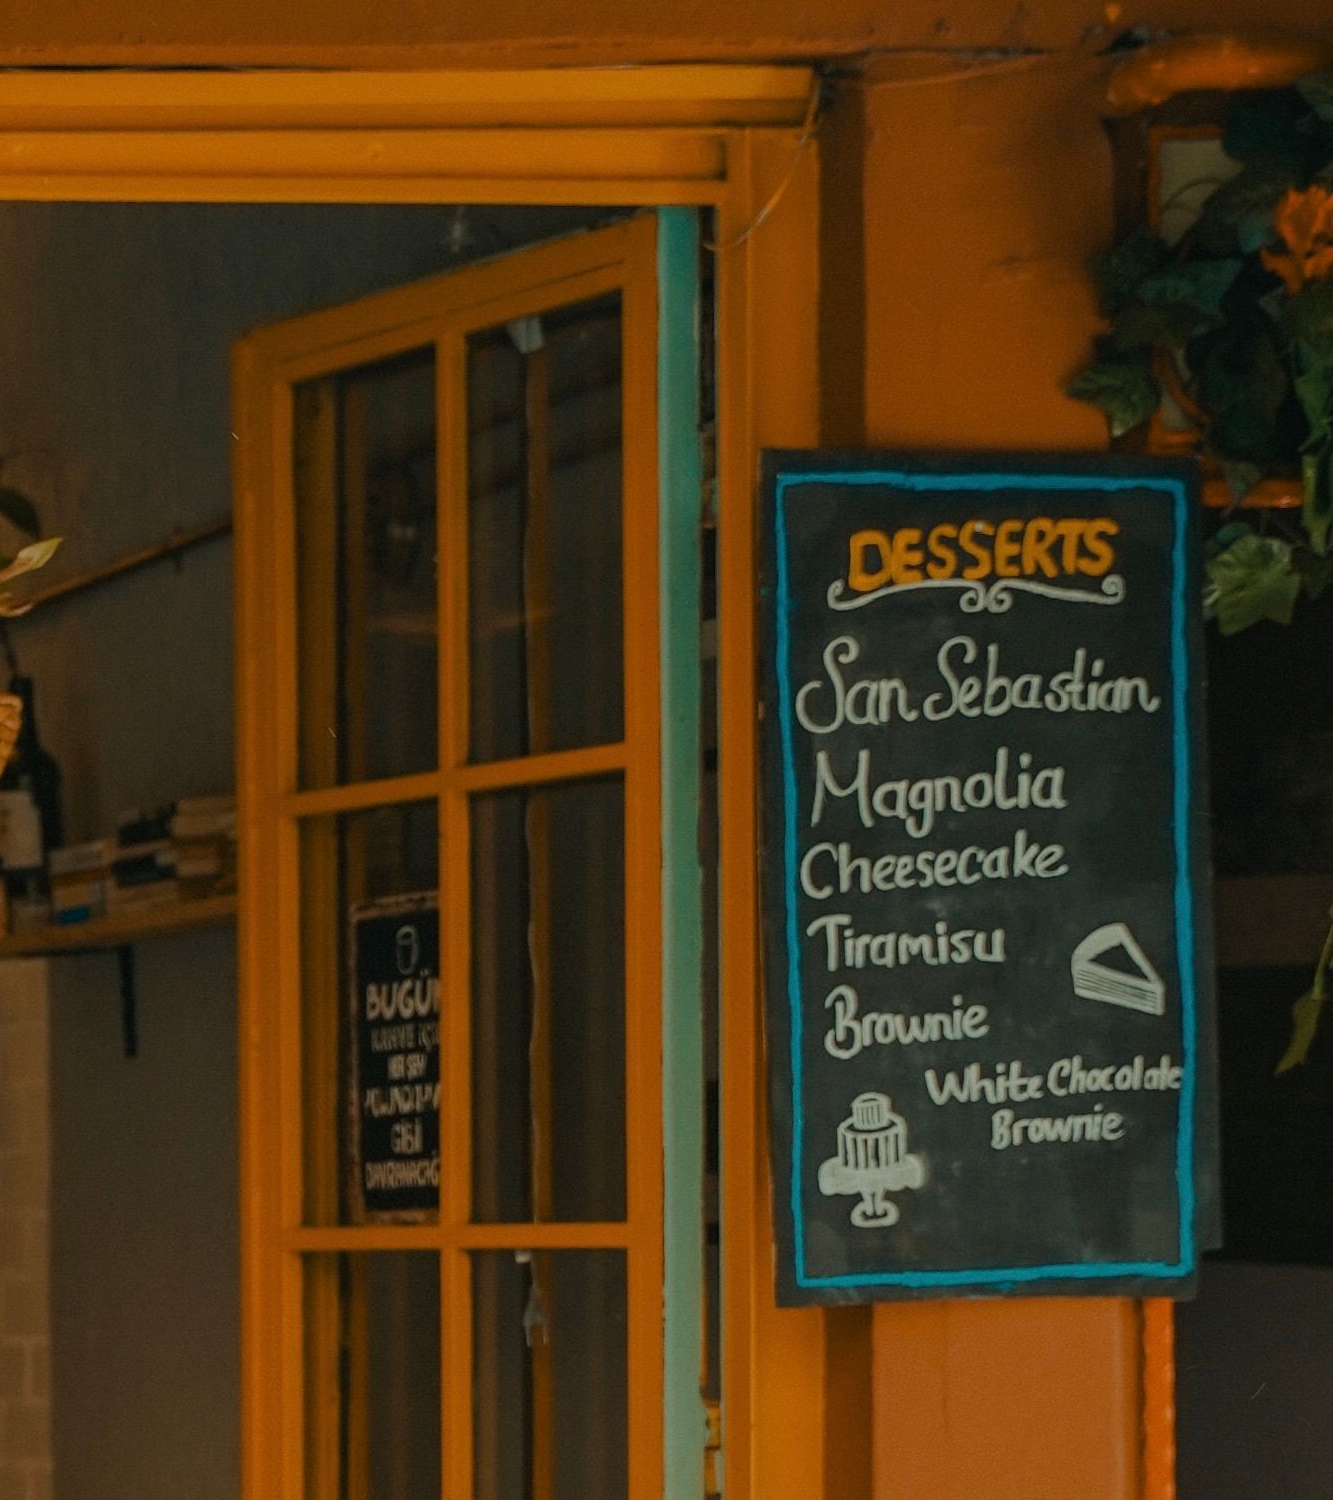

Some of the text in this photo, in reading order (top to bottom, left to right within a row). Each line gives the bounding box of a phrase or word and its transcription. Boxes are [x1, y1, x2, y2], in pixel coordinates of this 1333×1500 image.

[847, 516, 1121, 592] DESSERTS
[795, 635, 1162, 734] San Sebastian
[810, 746, 1069, 838] Magnolia
[799, 829, 1070, 900] Cheesecake
[806, 913, 1006, 972] Tiramisu
[824, 984, 990, 1059] Brownie
[923, 1053, 1184, 1105] White Chocolate
[990, 1103, 1126, 1150] Brownie
